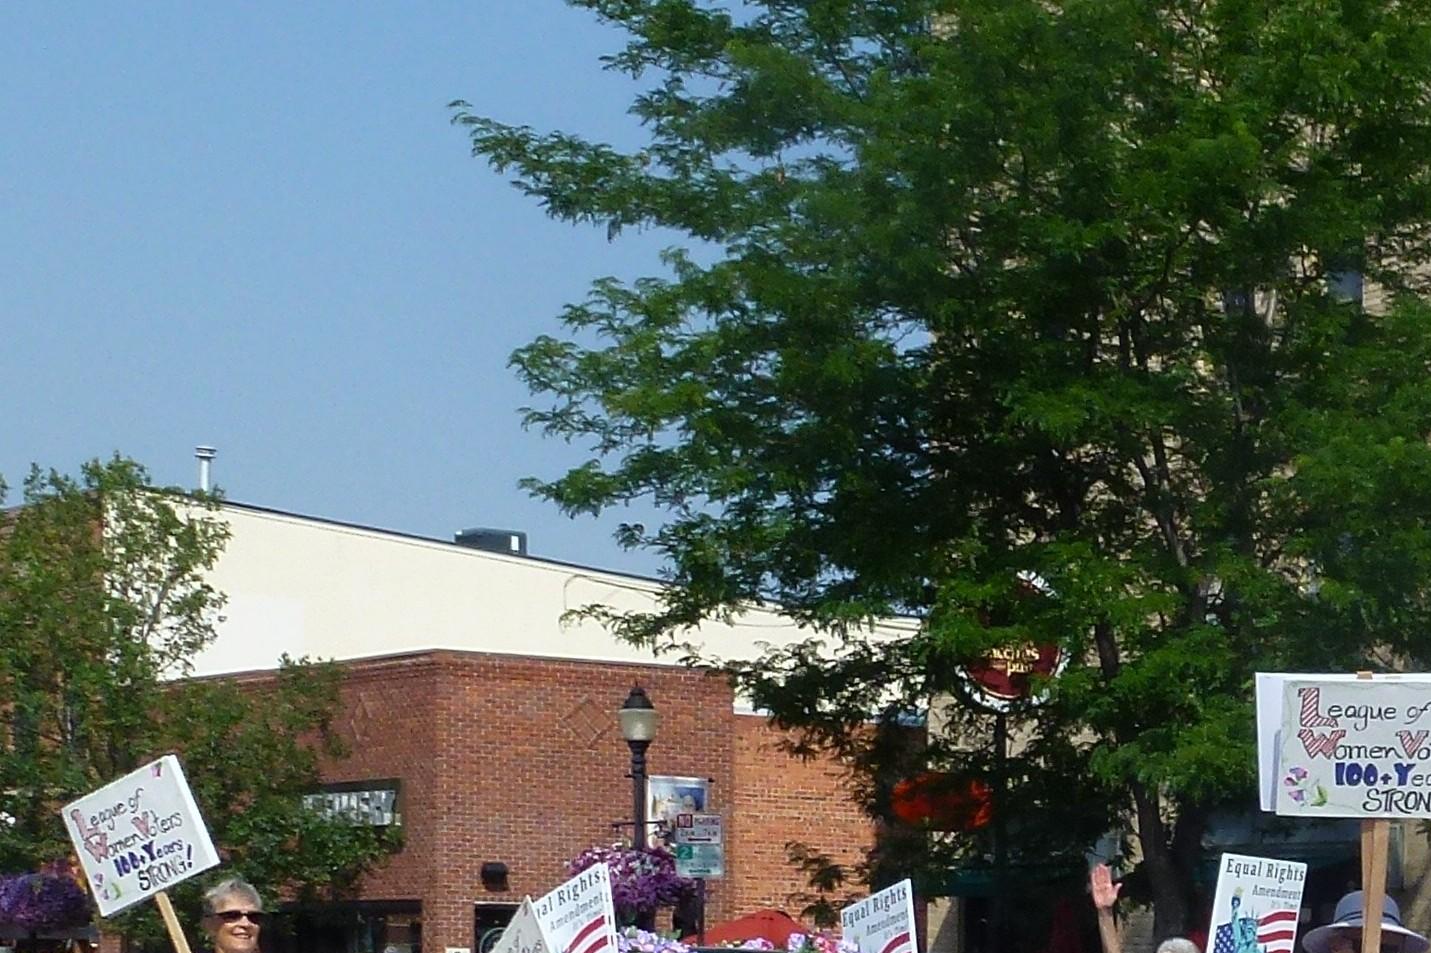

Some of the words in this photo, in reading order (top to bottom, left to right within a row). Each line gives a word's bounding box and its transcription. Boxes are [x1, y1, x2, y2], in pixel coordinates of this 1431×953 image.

[1298, 687, 1397, 732] League
[128, 787, 144, 814] of
[1226, 858, 1262, 878] Equal
[1266, 863, 1304, 884] Rights
[557, 870, 600, 908] Rights
[1252, 885, 1302, 900] Amendment
[842, 901, 869, 928] Equal
[873, 887, 907, 912] Rights
